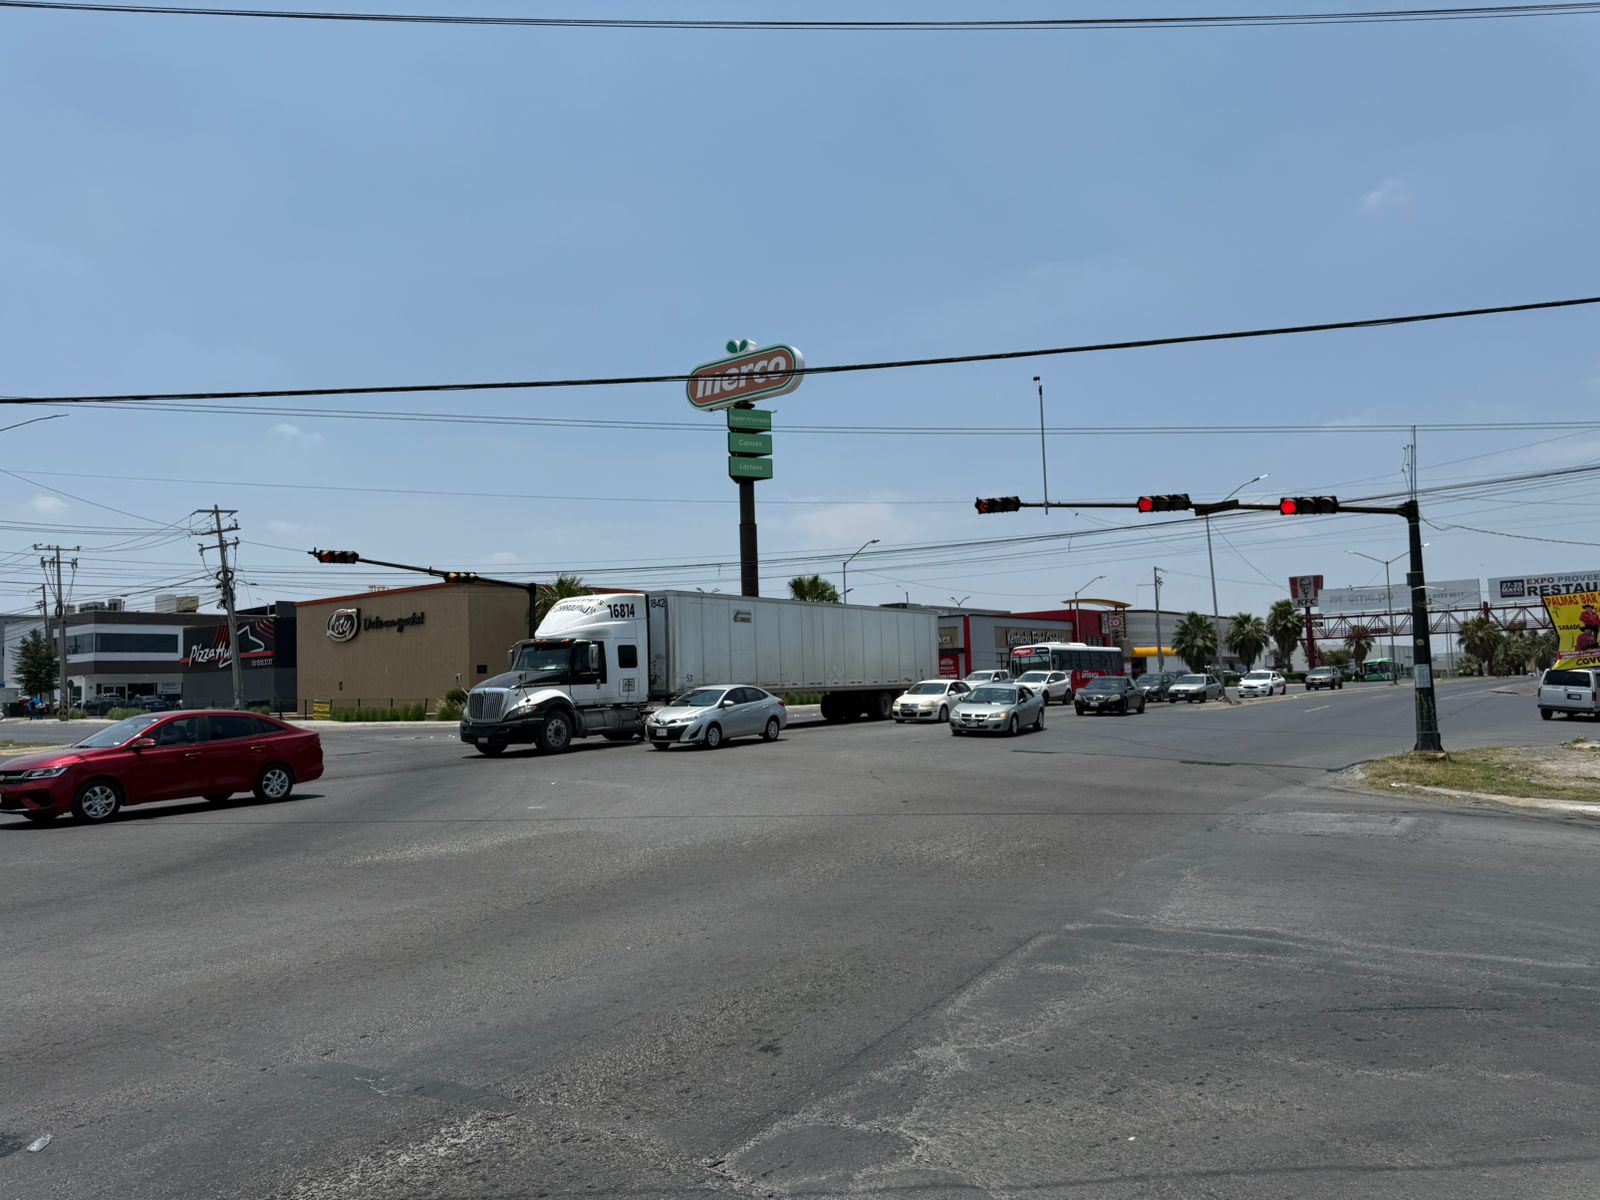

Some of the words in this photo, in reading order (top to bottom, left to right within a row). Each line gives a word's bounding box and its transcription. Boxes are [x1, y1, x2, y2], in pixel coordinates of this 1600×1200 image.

[696, 356, 786, 398] merco
[738, 438, 762, 447] Carnes
[1526, 577, 1554, 585] EXPO
[1297, 598, 1316, 607] KFC
[1546, 595, 1579, 607] PALMAS
[607, 603, 635, 618] 16814
[188, 643, 215, 668] Pizza
